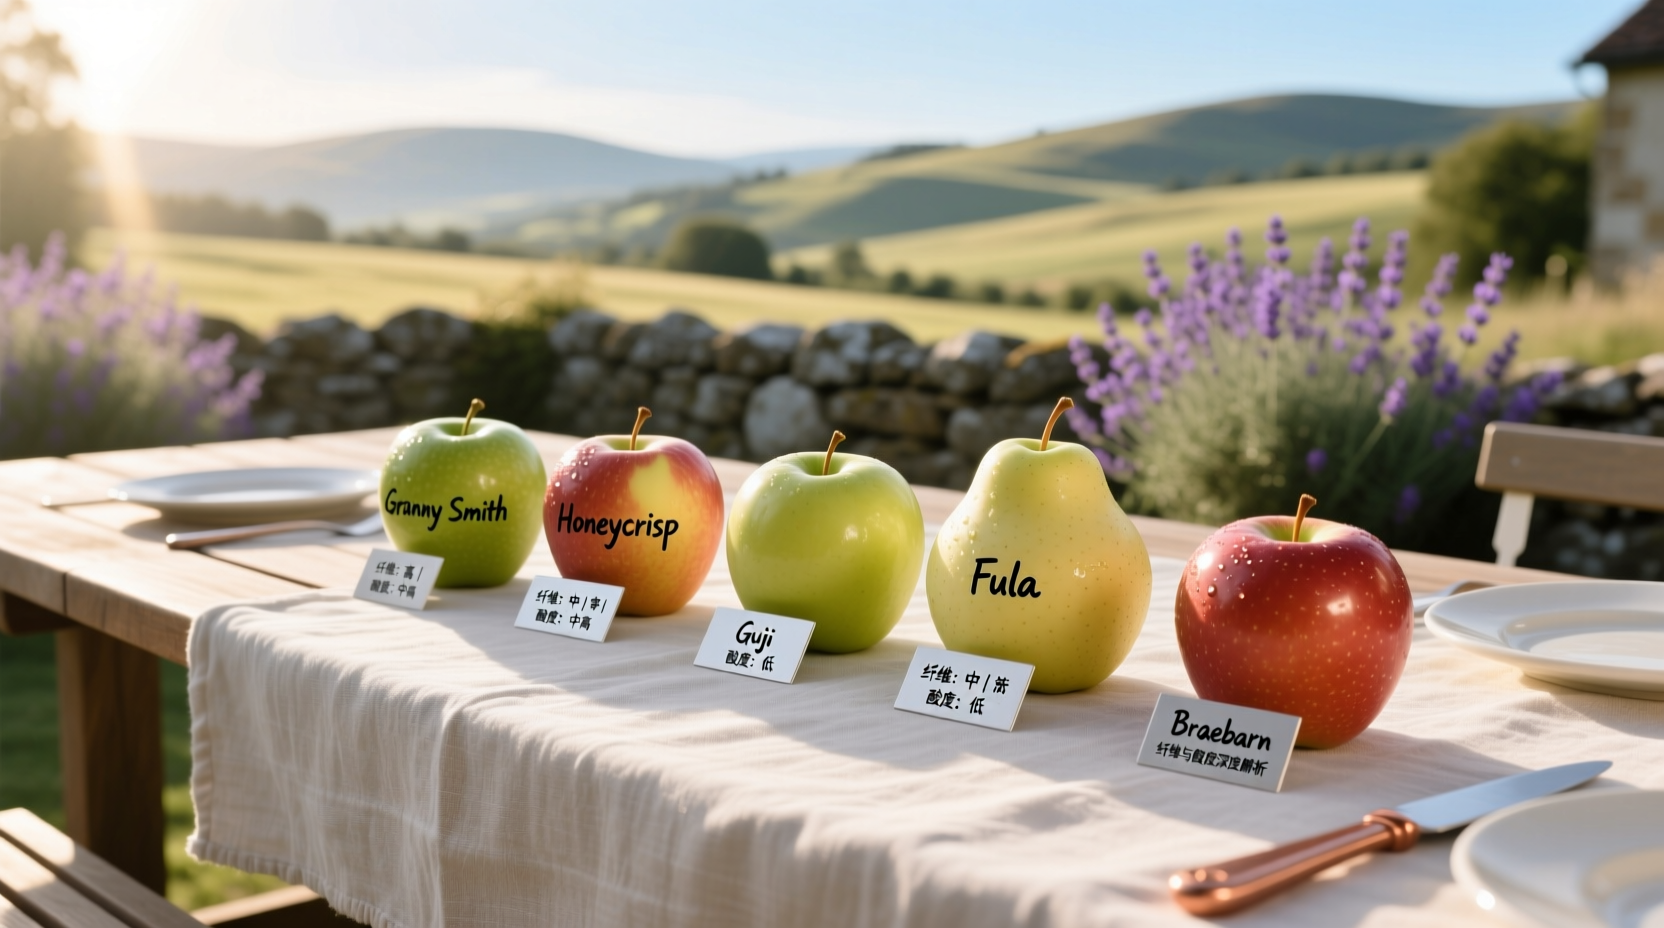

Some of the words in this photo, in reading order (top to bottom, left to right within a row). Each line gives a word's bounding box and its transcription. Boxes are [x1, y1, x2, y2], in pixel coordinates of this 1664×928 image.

[384, 488, 442, 531] Granny
[448, 494, 507, 523] Smith
[557, 502, 679, 551] Honeycrisp
[971, 557, 1041, 598] Fula
[736, 620, 776, 654] Guji
[1171, 709, 1271, 751] Braebarn
